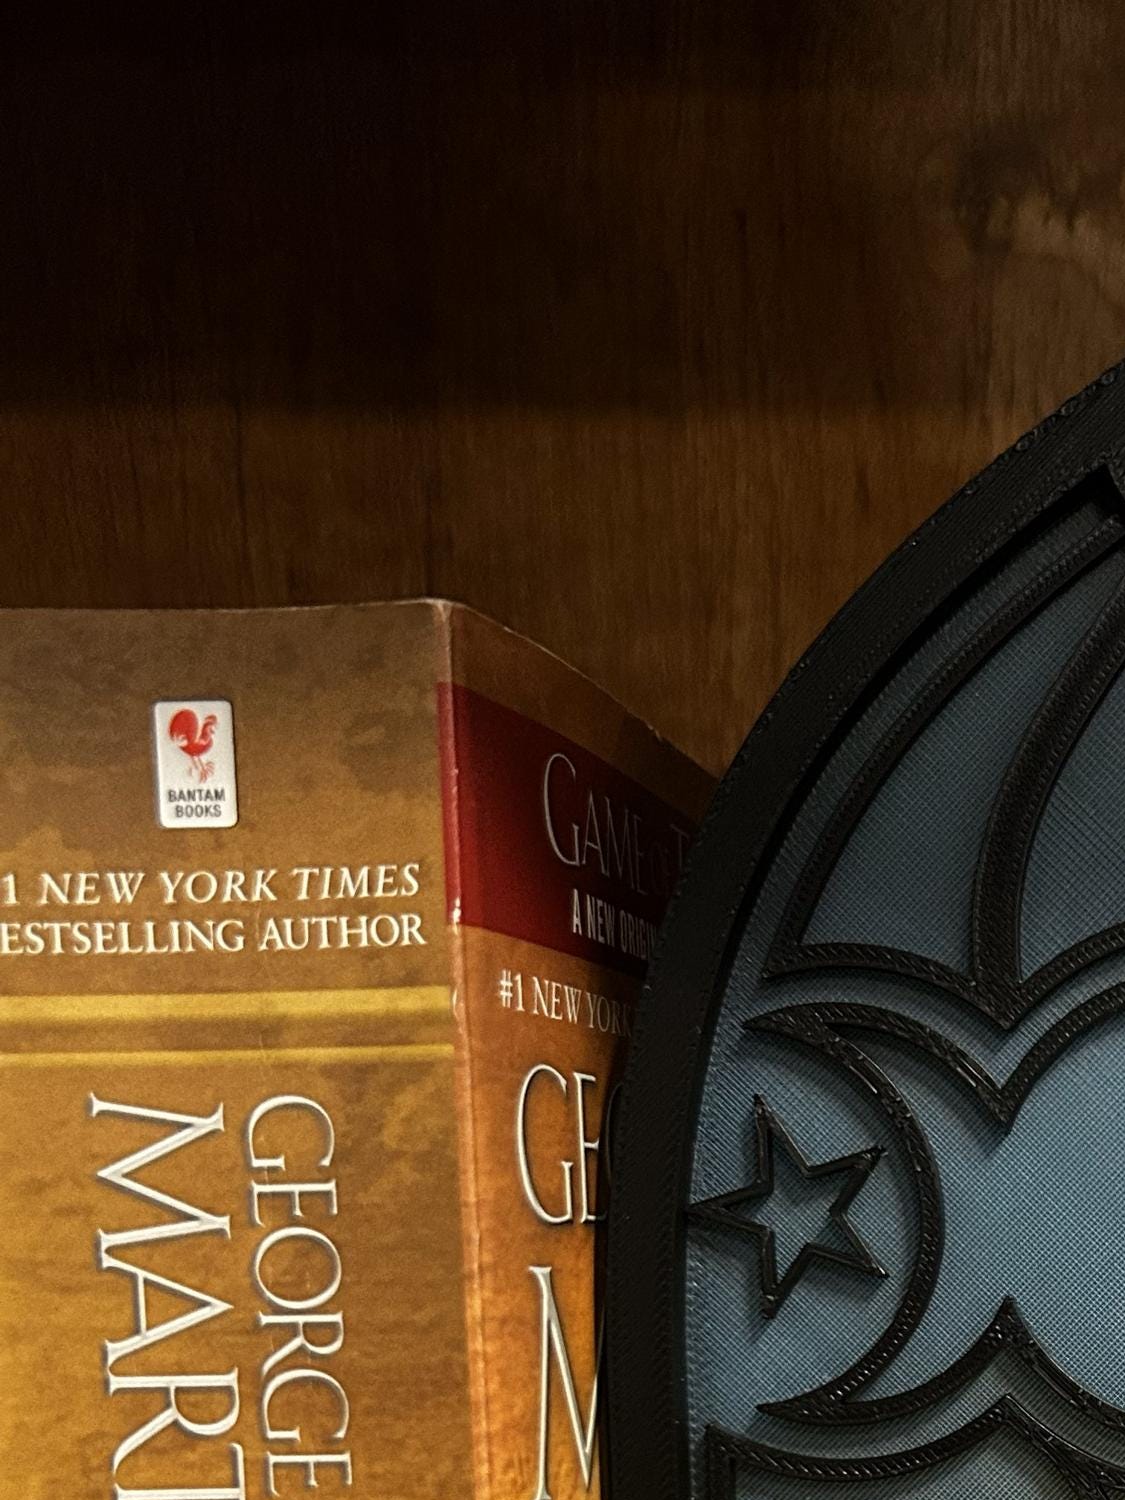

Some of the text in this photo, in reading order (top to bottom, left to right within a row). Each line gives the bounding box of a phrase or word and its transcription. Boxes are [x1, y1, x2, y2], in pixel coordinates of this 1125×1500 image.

[167, 788, 225, 803] BANTAM
[175, 804, 222, 819] BOOKS
[542, 751, 649, 896] GAME
[1, 862, 421, 908] 1 NEW YORK TIMES
[0, 913, 428, 956] ESTSELLING AUTHOR
[570, 887, 583, 937] A
[585, 892, 616, 949] NEW
[496, 966, 526, 1016] #1
[530, 975, 582, 1025] NEW
[245, 1094, 355, 1498] GEORGE
